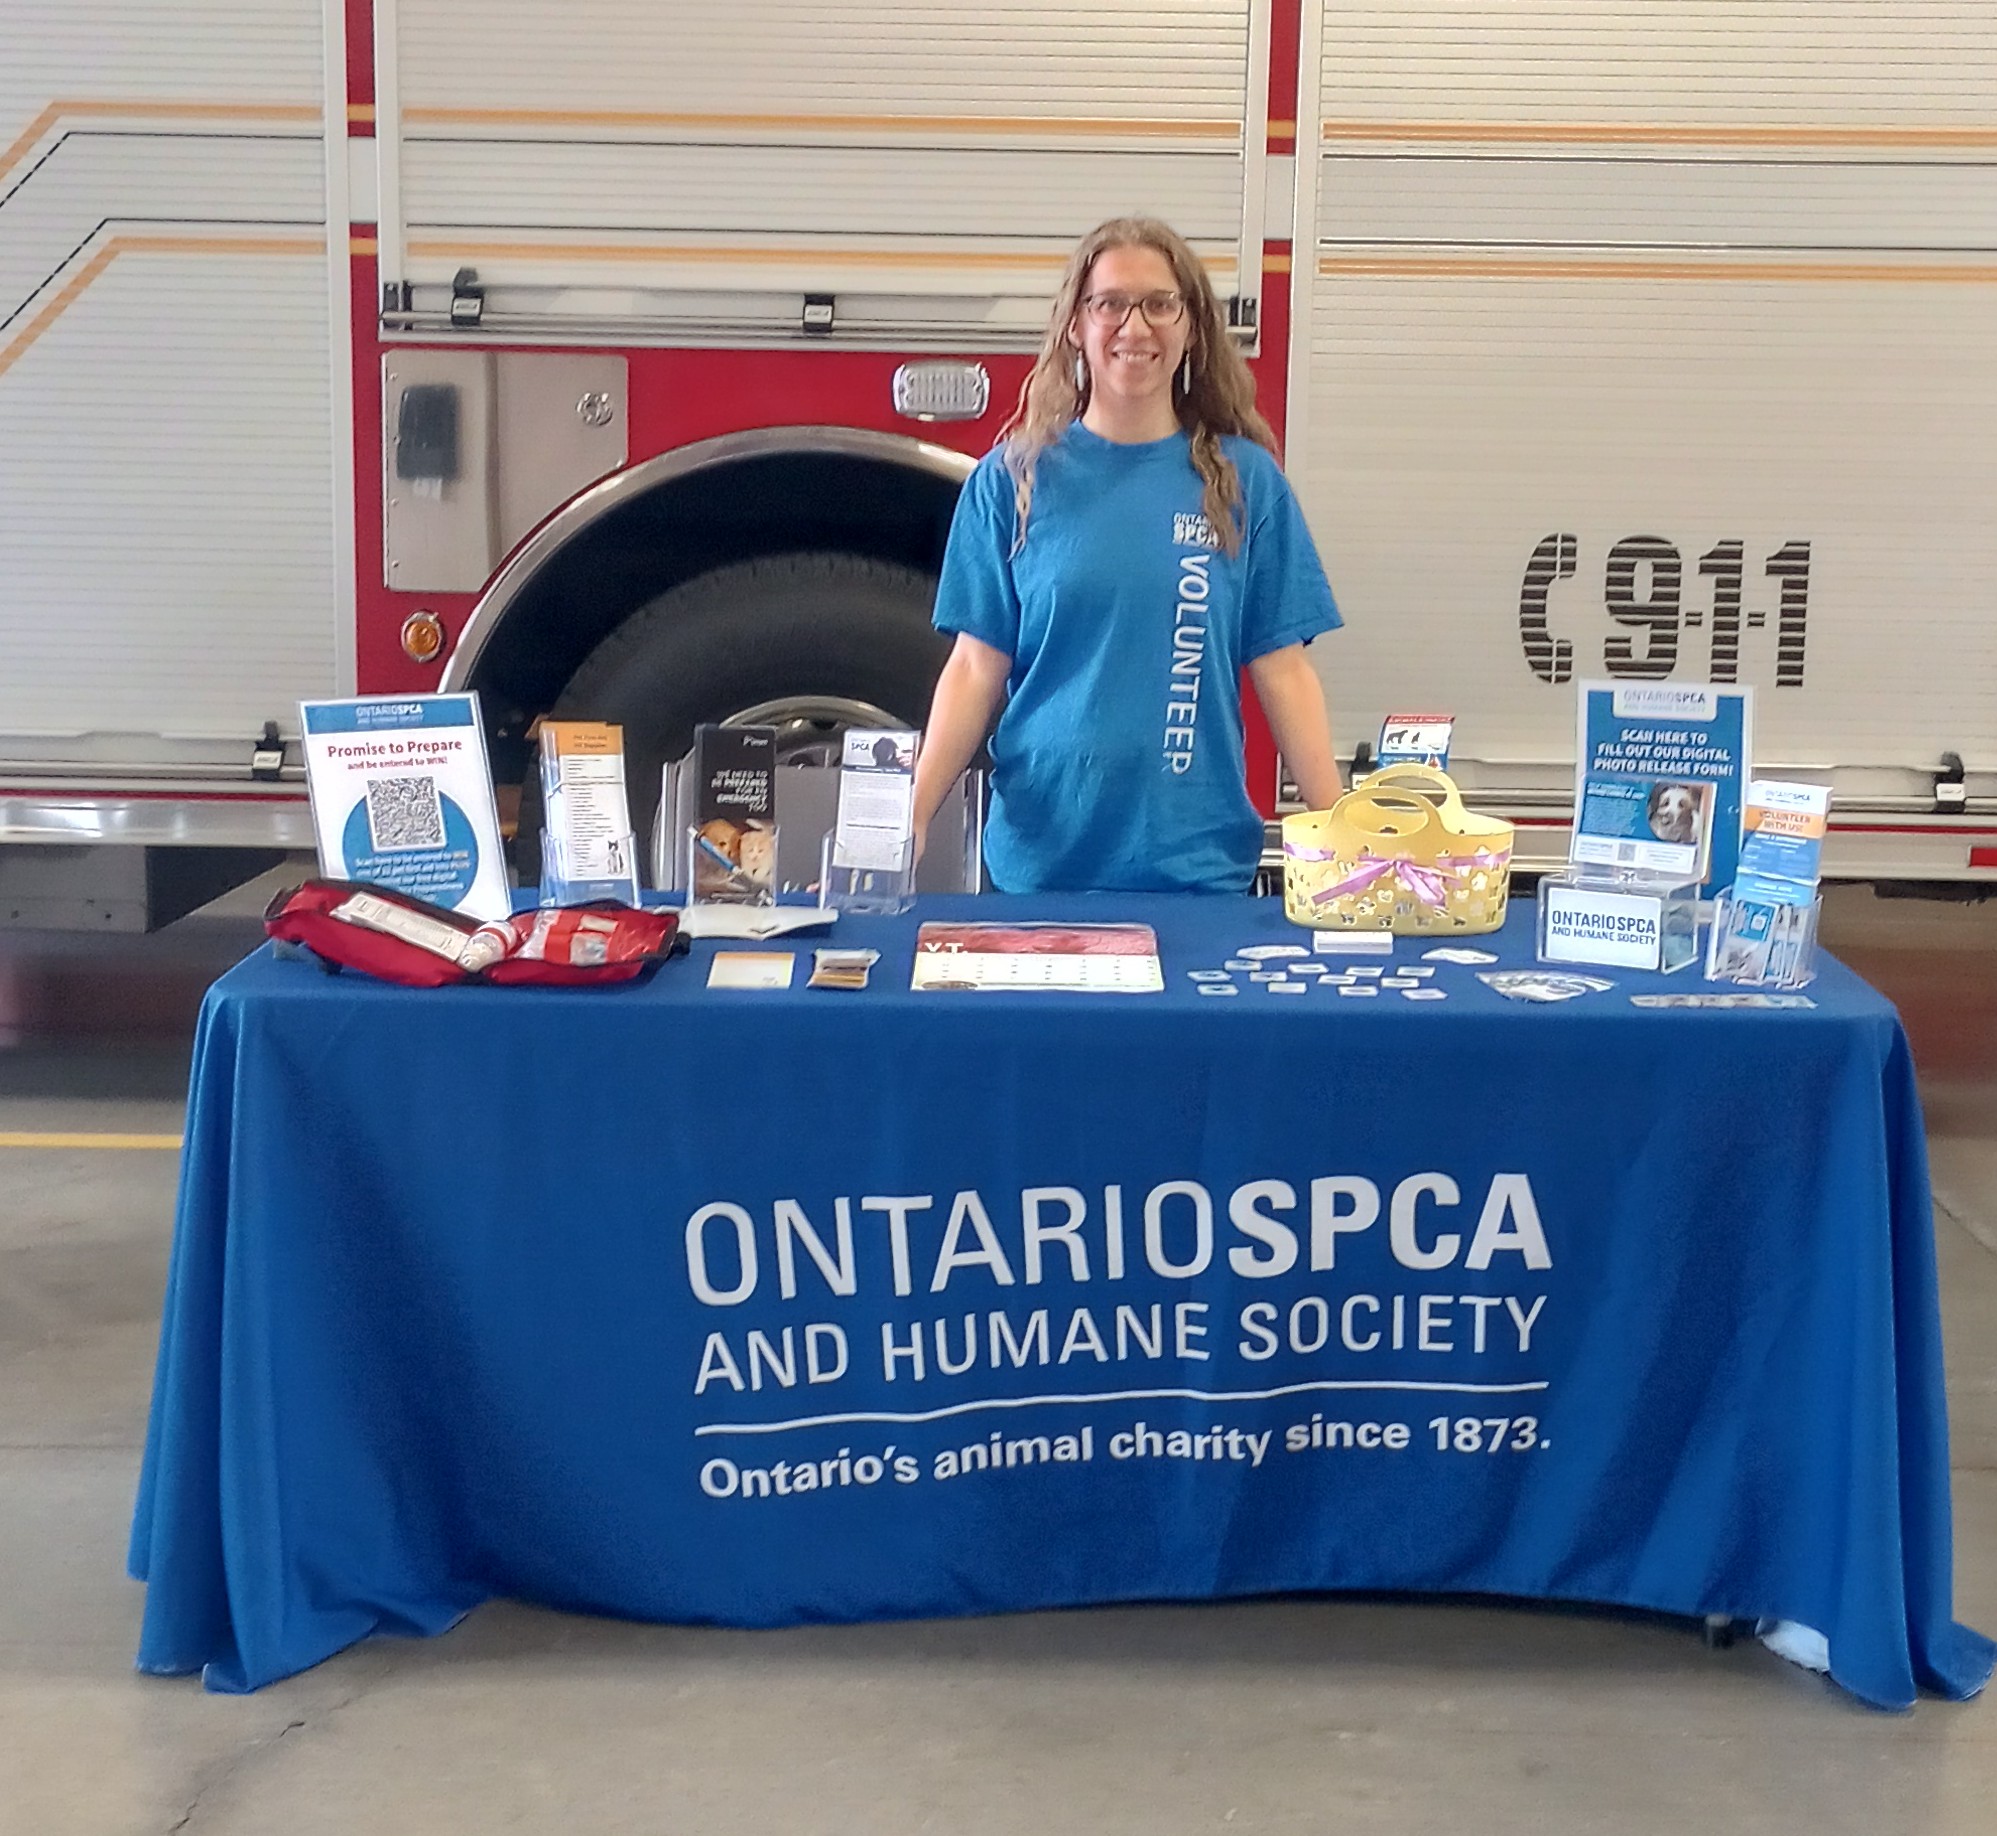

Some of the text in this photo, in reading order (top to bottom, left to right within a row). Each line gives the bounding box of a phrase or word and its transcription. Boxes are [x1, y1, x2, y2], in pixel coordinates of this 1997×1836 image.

[1620, 729, 1708, 745] SCAN HERE TO
[328, 740, 463, 757] Promise to Prepare
[1597, 743, 1731, 762] FILL OUT OUR DIGITAL
[347, 761, 365, 770] and
[366, 759, 378, 769] be
[415, 758, 425, 766] to
[1593, 758, 1734, 777] PHOTO RELEASE FORM!
[1551, 926, 1656, 945] AND HUMANE SOCIETY
[685, 1172, 1553, 1307] ONTARIOSPCA
[694, 1295, 1548, 1395] AND HUMANE SOCIETY
[699, 1413, 1551, 1498] Ontario's animal charity since 1873.
